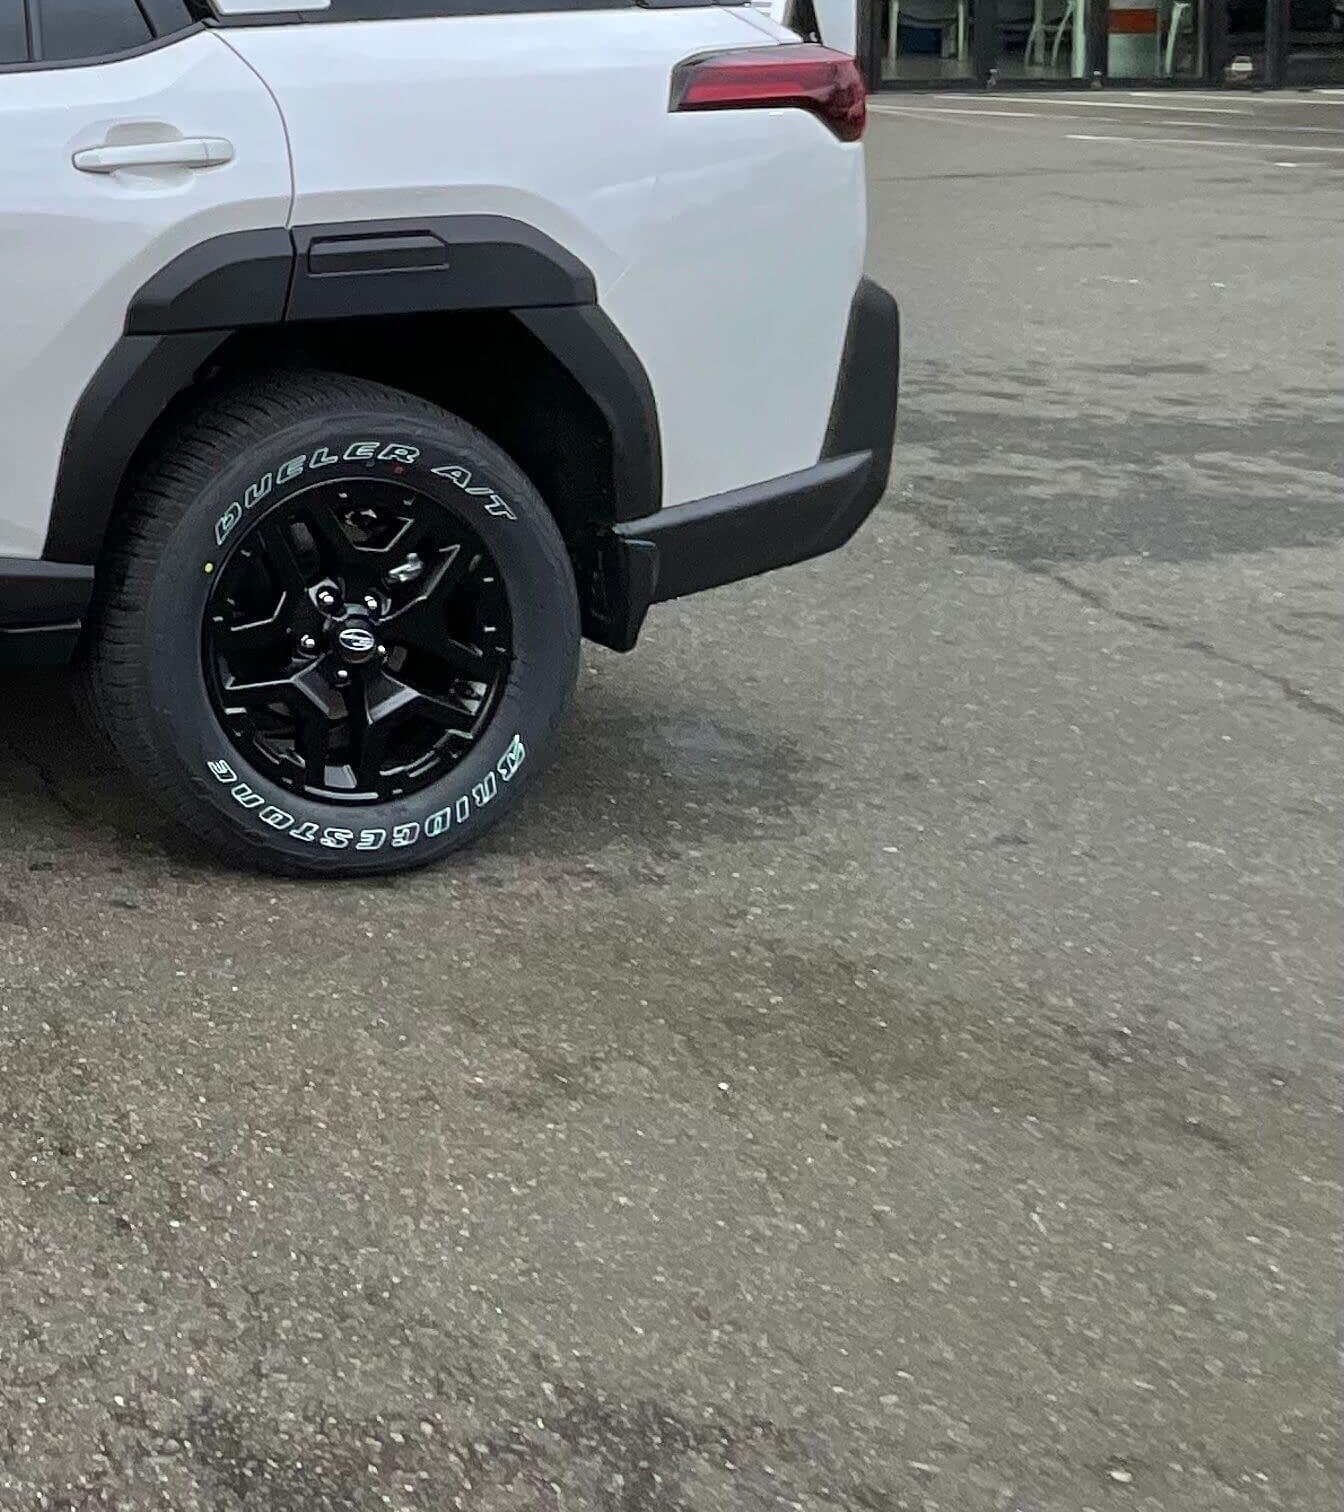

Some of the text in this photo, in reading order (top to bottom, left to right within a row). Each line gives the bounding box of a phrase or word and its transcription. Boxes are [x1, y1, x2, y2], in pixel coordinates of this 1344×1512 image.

[215, 442, 517, 545] DUELER A/T
[207, 734, 526, 850] BRIDGESTONE
